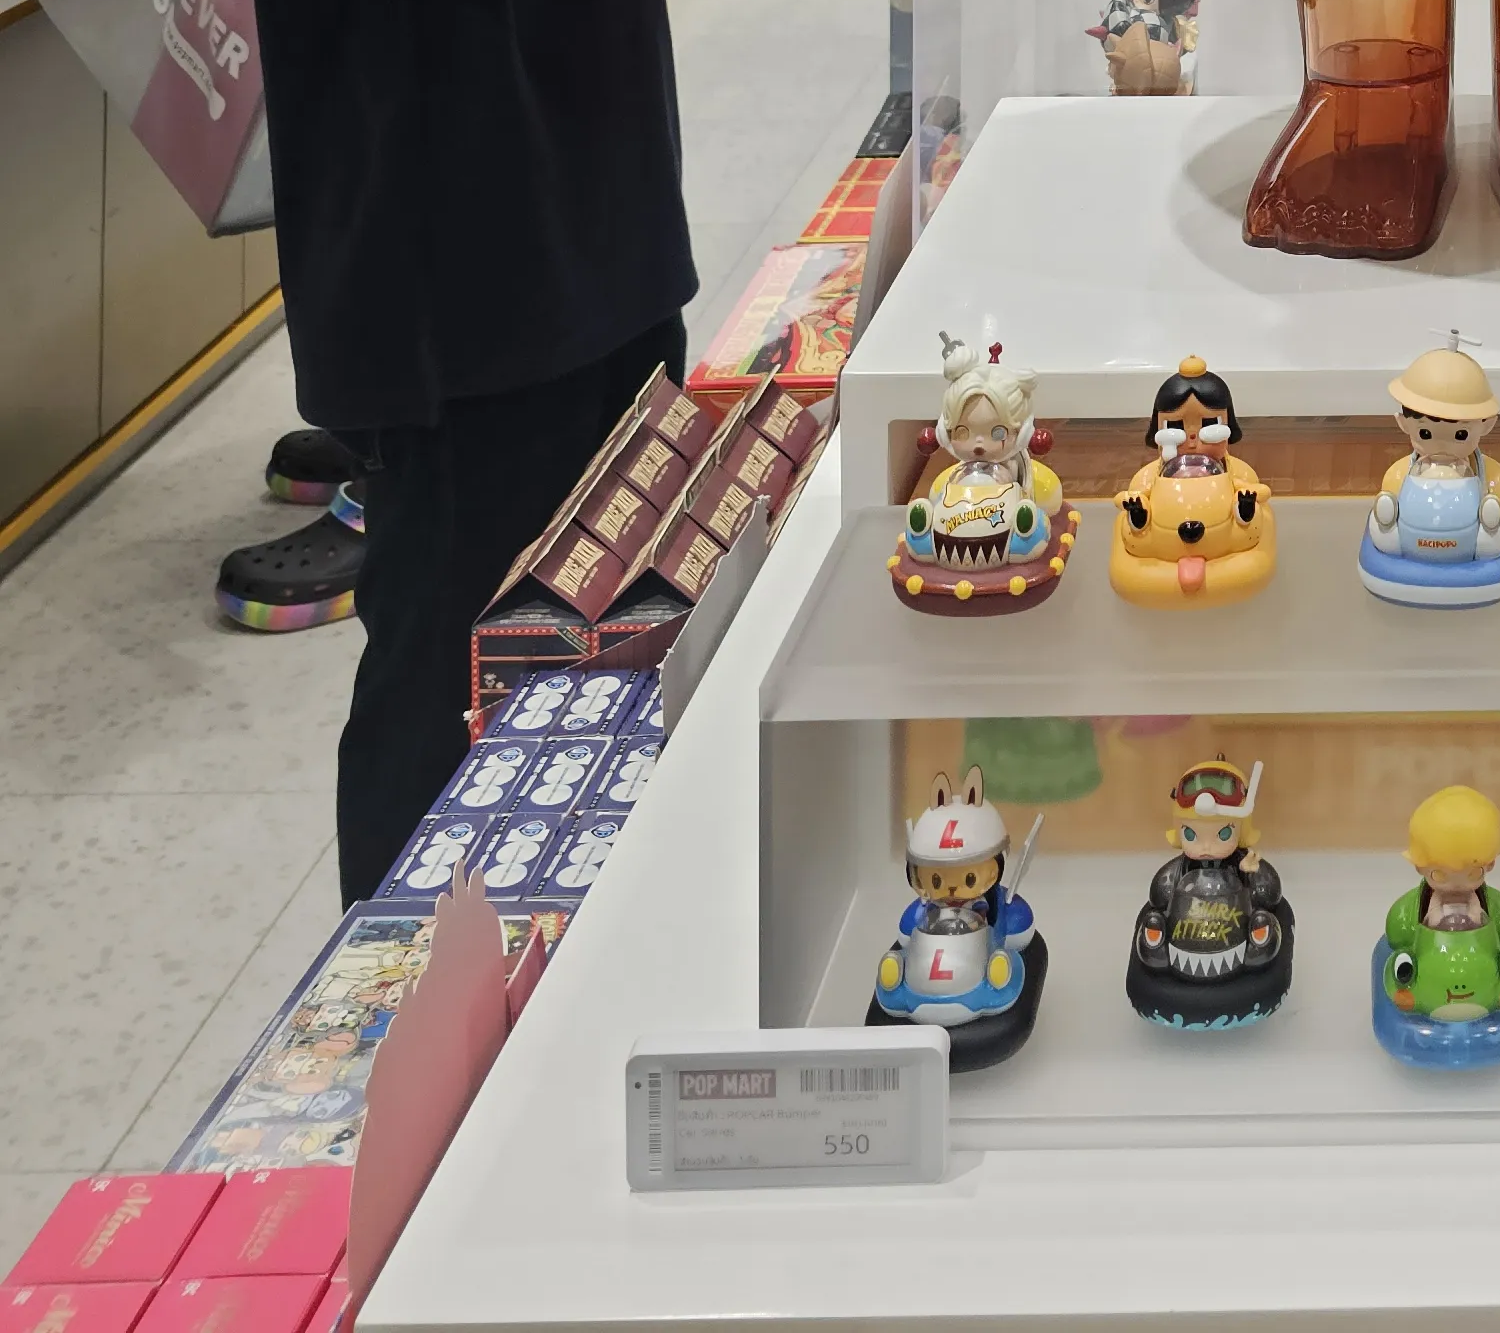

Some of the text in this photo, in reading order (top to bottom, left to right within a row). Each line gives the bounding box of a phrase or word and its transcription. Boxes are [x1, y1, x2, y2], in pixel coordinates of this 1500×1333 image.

[939, 819, 964, 850] L
[1188, 896, 1244, 928] SHARK
[1172, 918, 1234, 948] ATTACK
[929, 948, 955, 982] L
[683, 1072, 772, 1097] POP MART
[823, 1133, 870, 1156] 550
